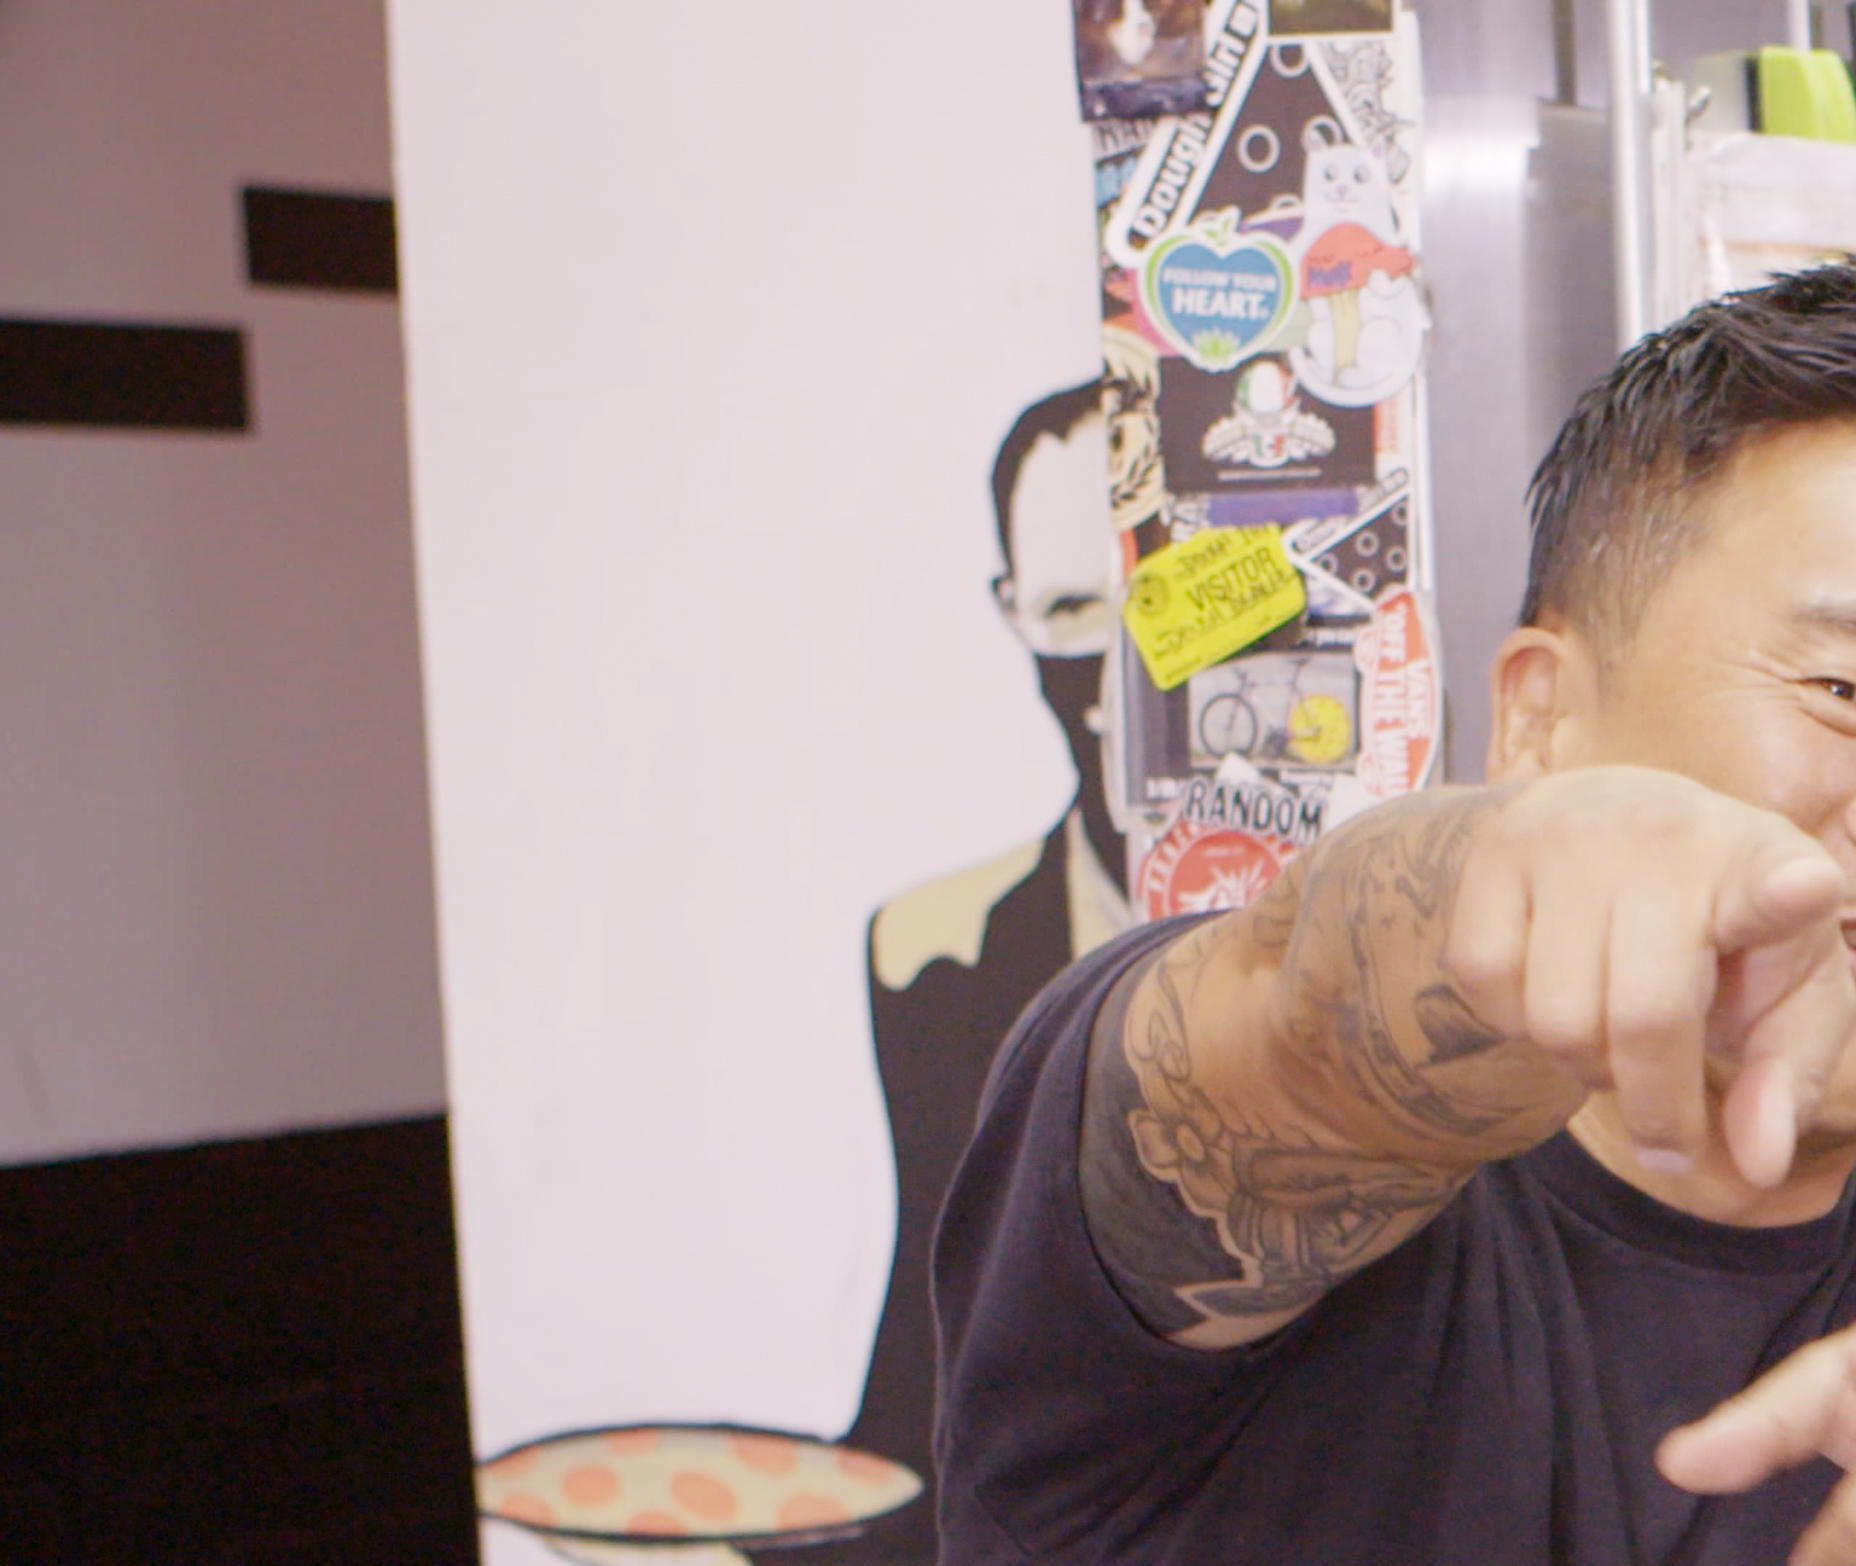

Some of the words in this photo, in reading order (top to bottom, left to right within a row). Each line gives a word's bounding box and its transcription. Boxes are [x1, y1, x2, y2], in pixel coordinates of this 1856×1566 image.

[1162, 267, 1231, 288] FOLLOW
[1232, 272, 1277, 292] YOUR
[1185, 546, 1278, 612] VISITOR
[1373, 667, 1408, 724] THE
[1404, 658, 1431, 739] VANS
[1185, 779, 1322, 841] RANDOM
